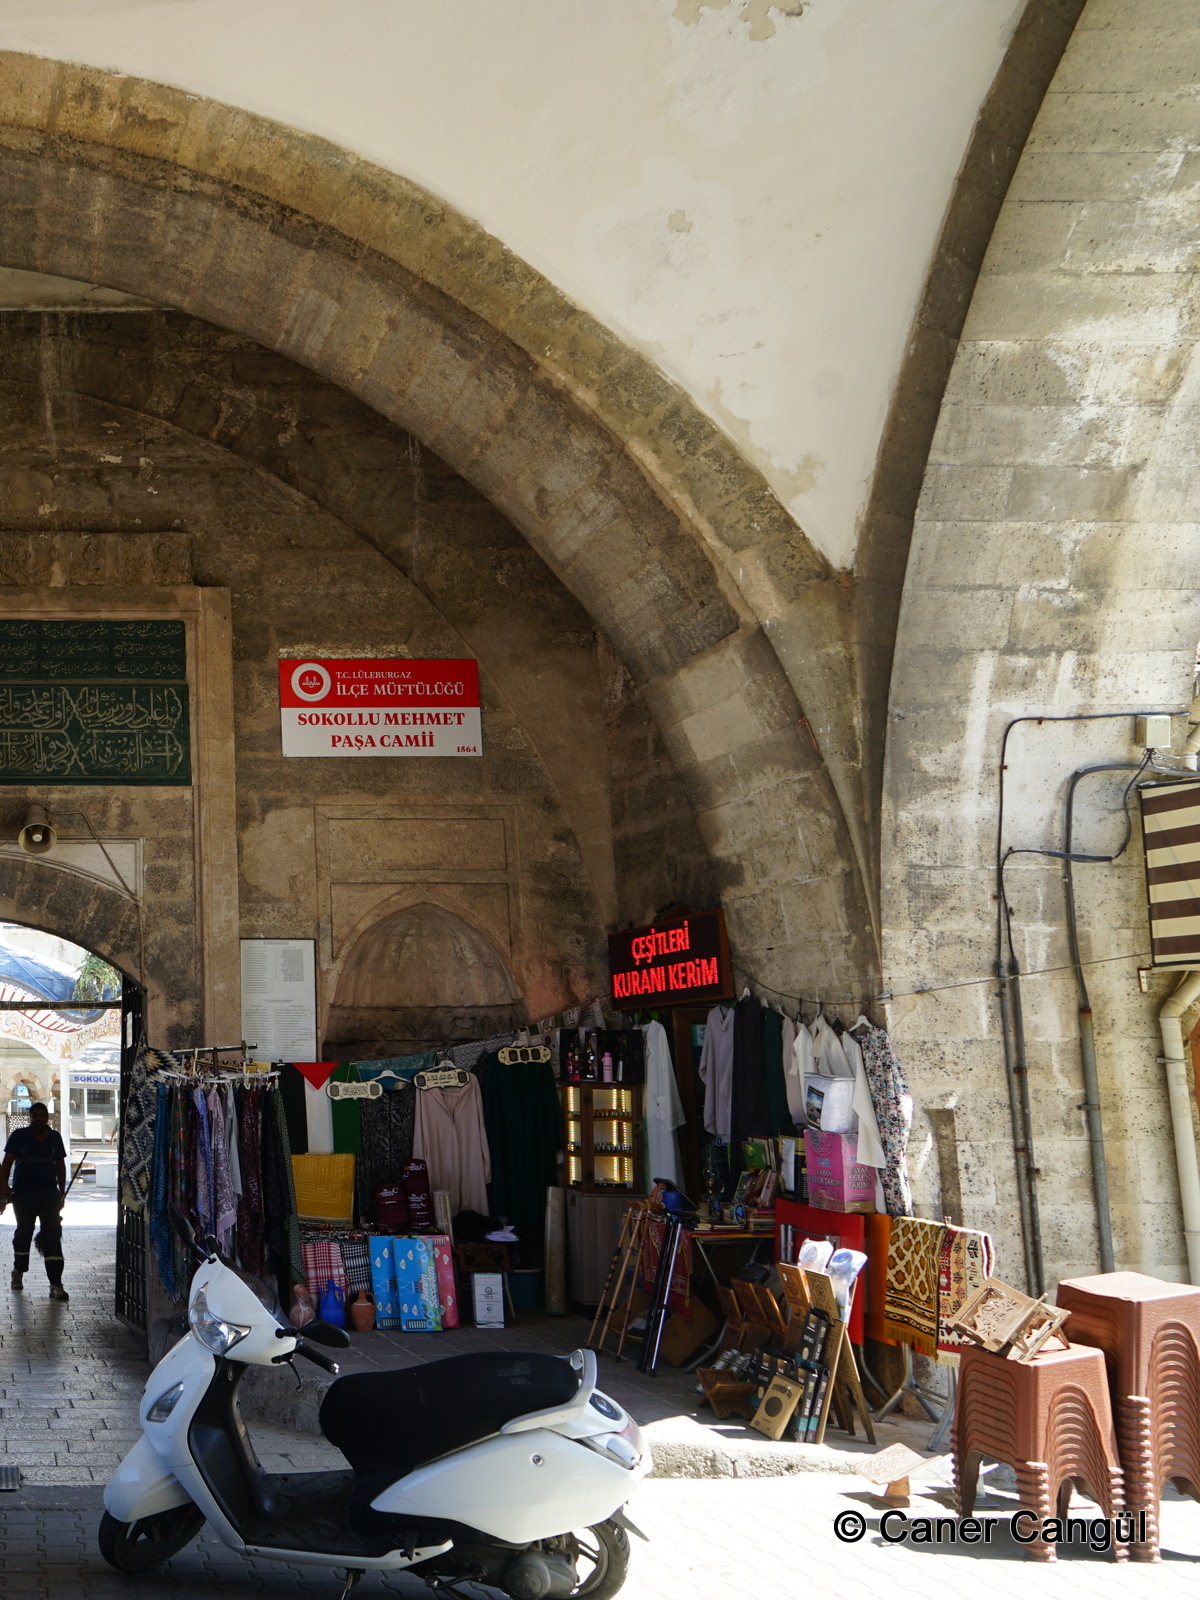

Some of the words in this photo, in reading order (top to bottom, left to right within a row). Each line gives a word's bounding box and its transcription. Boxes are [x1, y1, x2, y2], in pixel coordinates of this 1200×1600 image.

[336, 671, 351, 679] T.C.
[352, 670, 412, 679] LÜLEBURGAZ
[336, 681, 369, 698] İLÇE
[373, 681, 464, 696] MÜFTÜLÜĞÜ
[297, 712, 380, 726] SOKOLLU
[383, 712, 465, 726] MEHMET
[330, 734, 376, 750] PAŞA
[379, 731, 435, 748] CAMİİ
[631, 920, 690, 966] ÇEŞİTLERİ
[613, 966, 667, 998] KURANI
[668, 956, 719, 991] KERİM
[74, 1075, 116, 1083] SOKOLLU
